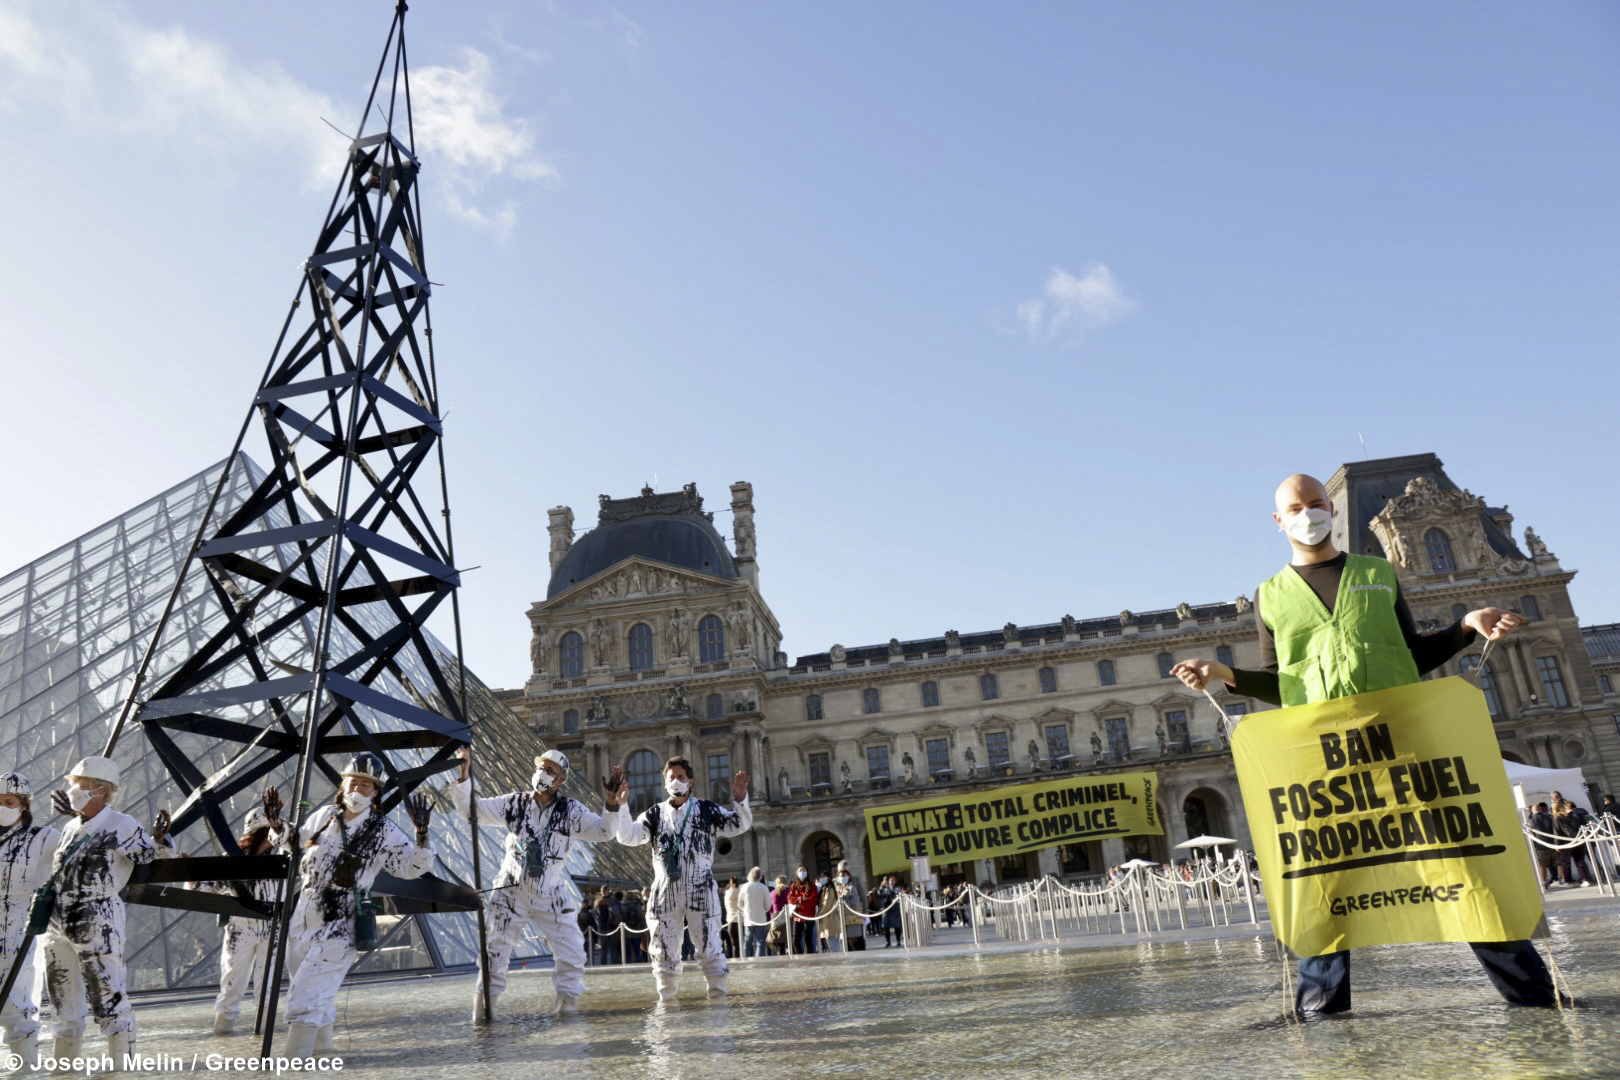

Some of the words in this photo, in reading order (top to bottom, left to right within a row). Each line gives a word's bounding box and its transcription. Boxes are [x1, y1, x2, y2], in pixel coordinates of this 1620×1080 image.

[1319, 722, 1396, 770] BAN
[963, 796, 1030, 824] TOTAL
[1033, 782, 1138, 813] CRIMINEL,
[1143, 777, 1157, 827] GREENPEACE
[1268, 771, 1386, 824] FOSSIL
[1388, 755, 1481, 805] FUEL
[903, 837, 929, 859] LE
[932, 825, 1014, 856] LOUVRE
[1017, 807, 1118, 842] COMPLICE
[1279, 802, 1494, 864] PROPAGANDA
[1329, 884, 1464, 916] GREENPEACE
